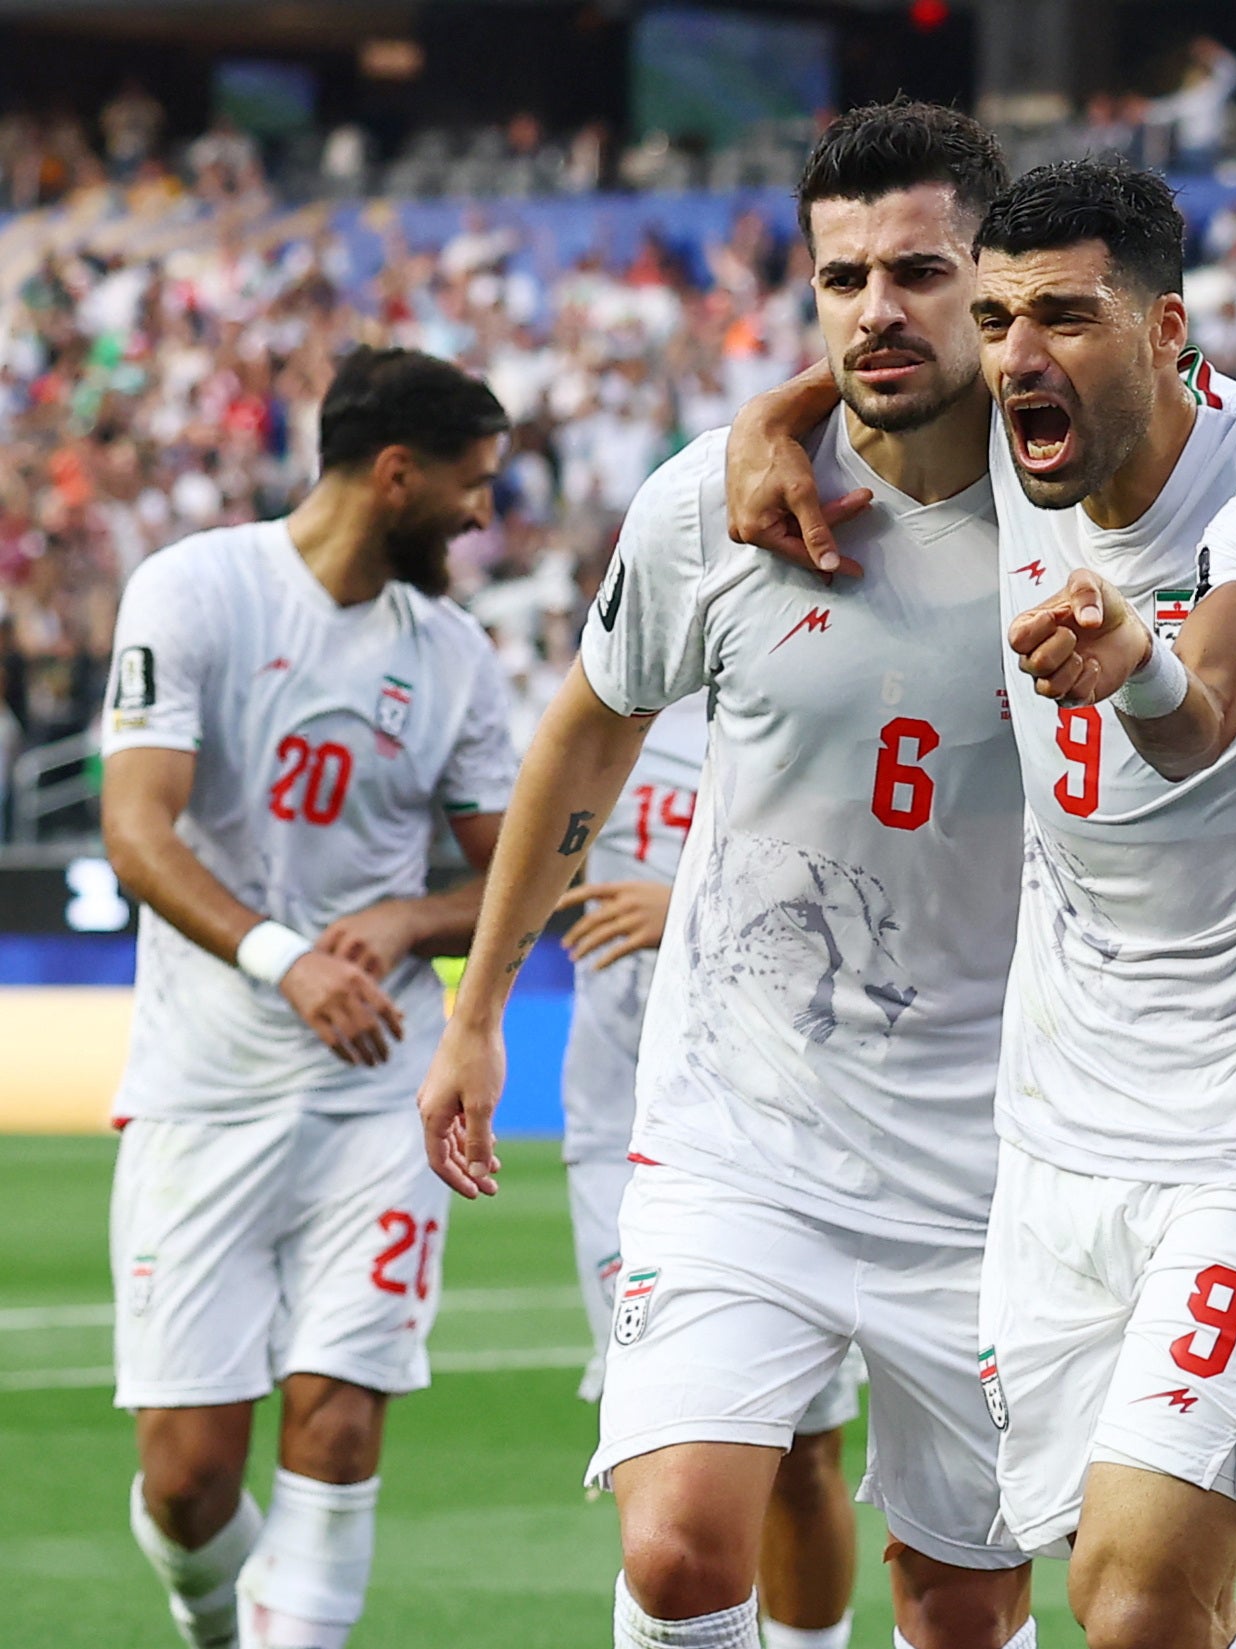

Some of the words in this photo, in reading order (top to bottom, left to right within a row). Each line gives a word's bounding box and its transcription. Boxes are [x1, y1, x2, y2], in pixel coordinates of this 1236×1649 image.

[270, 735, 353, 825] 20
[871, 716, 940, 831] 6
[1054, 705, 1103, 819] 9
[632, 784, 697, 862] 14
